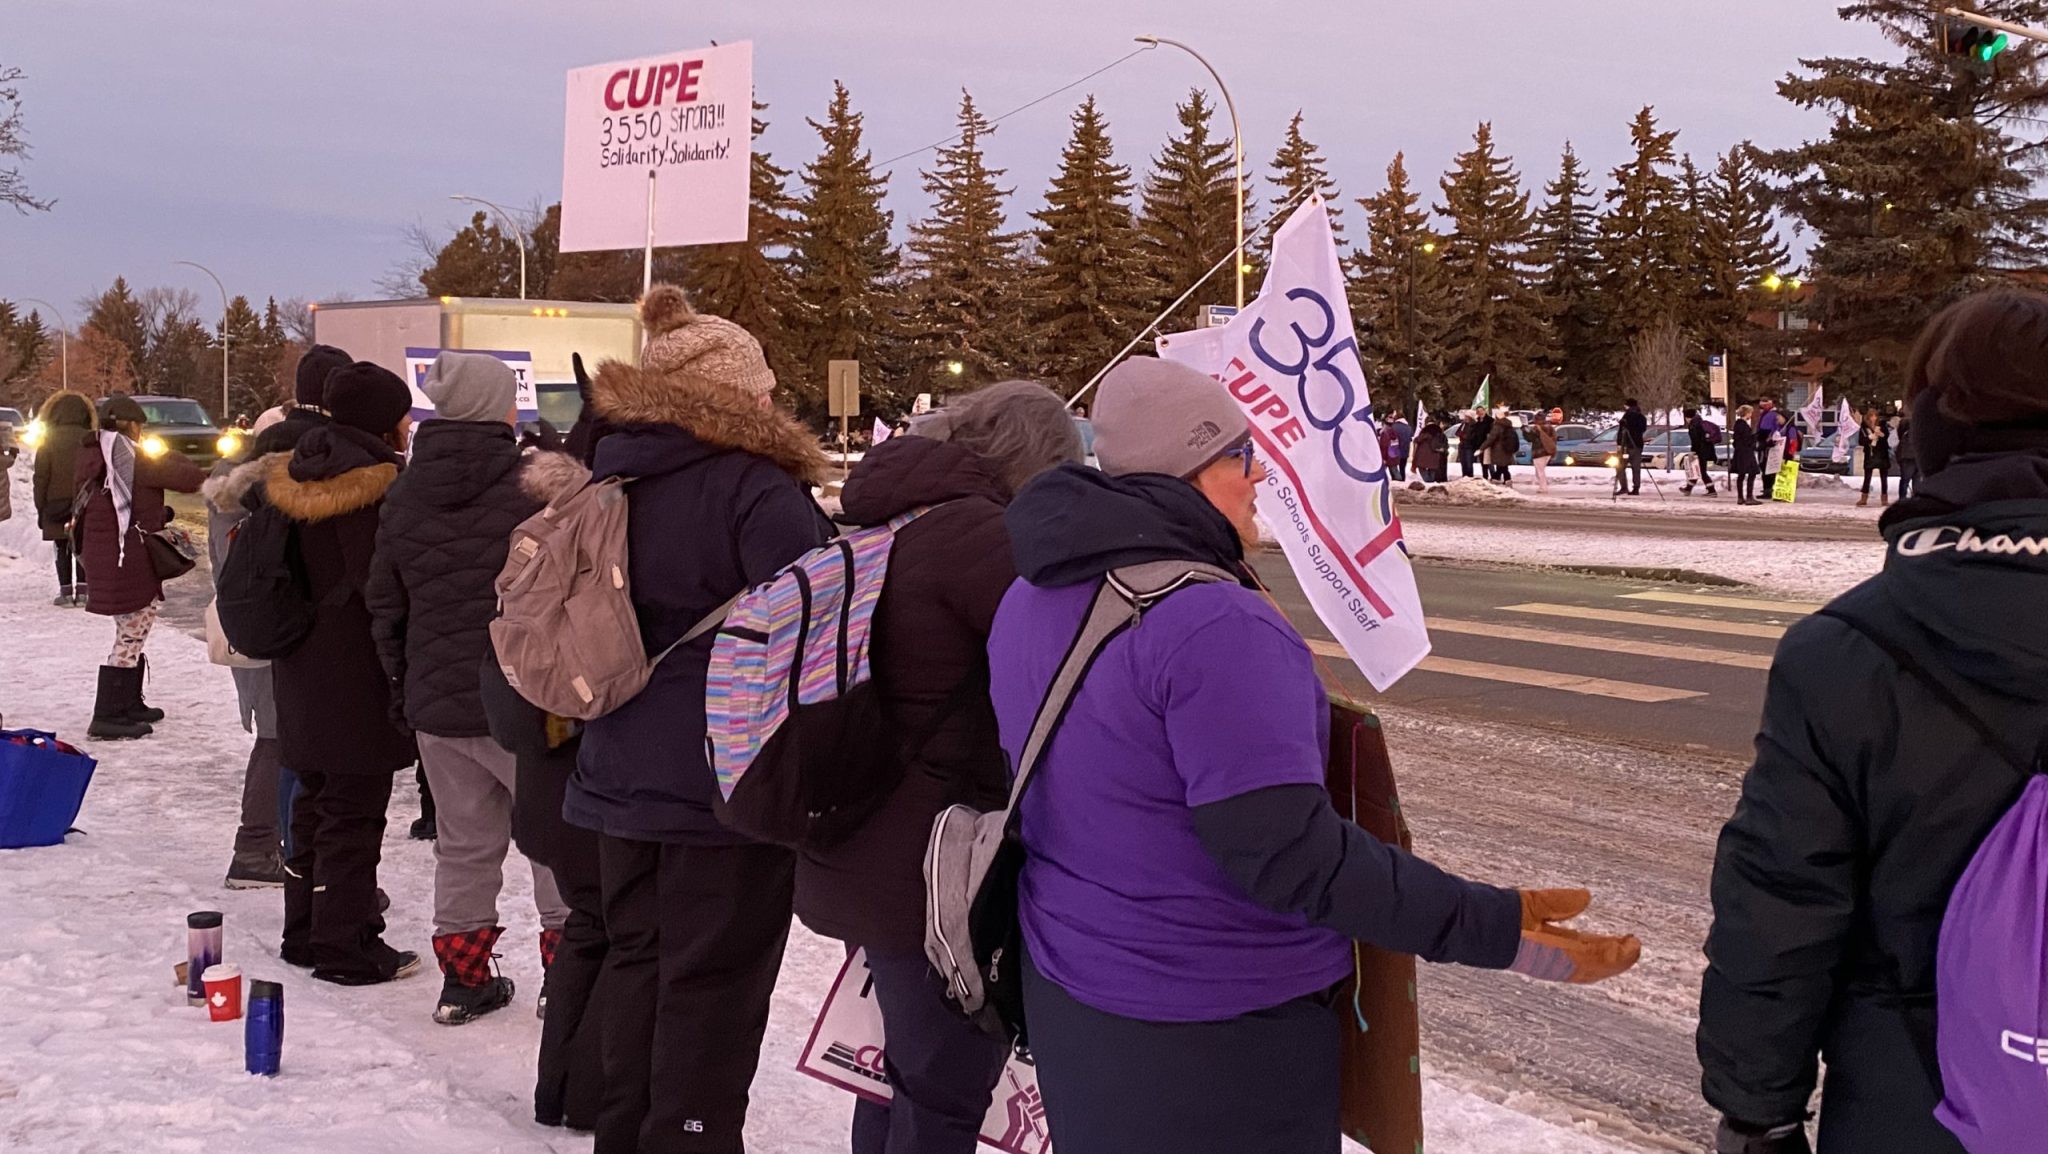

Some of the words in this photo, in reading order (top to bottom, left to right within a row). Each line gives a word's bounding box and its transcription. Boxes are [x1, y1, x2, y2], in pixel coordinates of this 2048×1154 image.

[604, 59, 704, 112] CUPE
[600, 110, 662, 147] 3550
[670, 103, 725, 133] Strong!!
[1276, 486, 1310, 544] Schools
[1307, 543, 1352, 600] Support
[1347, 598, 1382, 632] Staff
